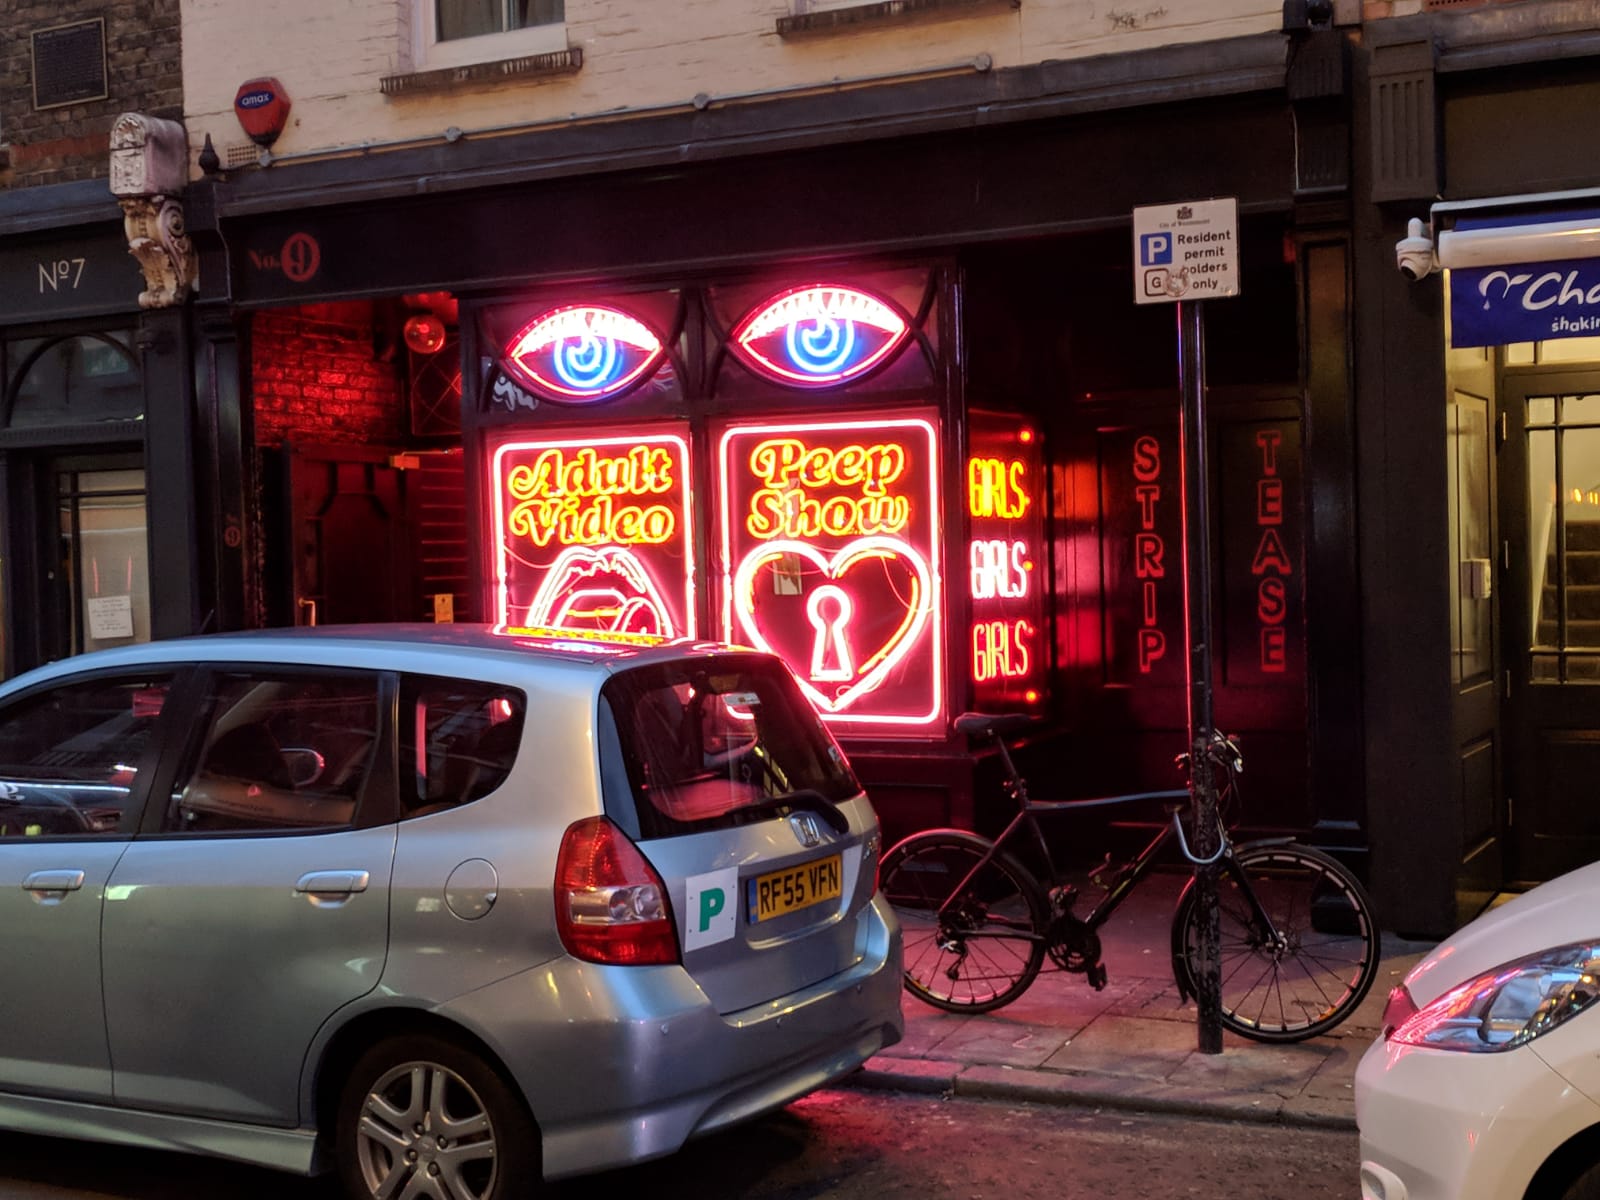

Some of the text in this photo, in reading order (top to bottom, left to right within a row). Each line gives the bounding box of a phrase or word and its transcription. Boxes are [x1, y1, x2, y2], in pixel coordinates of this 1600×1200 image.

[241, 93, 270, 106] amax
[1147, 236, 1168, 264] P
[1177, 230, 1231, 245] Resident
[1184, 246, 1225, 261] permit
[1151, 277, 1161, 288] G
[1192, 277, 1219, 290] only
[508, 446, 673, 499] Adult
[750, 439, 905, 497] Peep
[968, 457, 1026, 519] GIRLS
[509, 495, 675, 546] Video
[747, 489, 909, 538] Show
[970, 539, 1027, 599] GIRLS
[1133, 435, 1166, 674] STRIP
[1252, 430, 1292, 673] TEASE
[973, 620, 1029, 682] GIRLS
[699, 888, 725, 932] P
[759, 861, 838, 914] RF55 VFN
